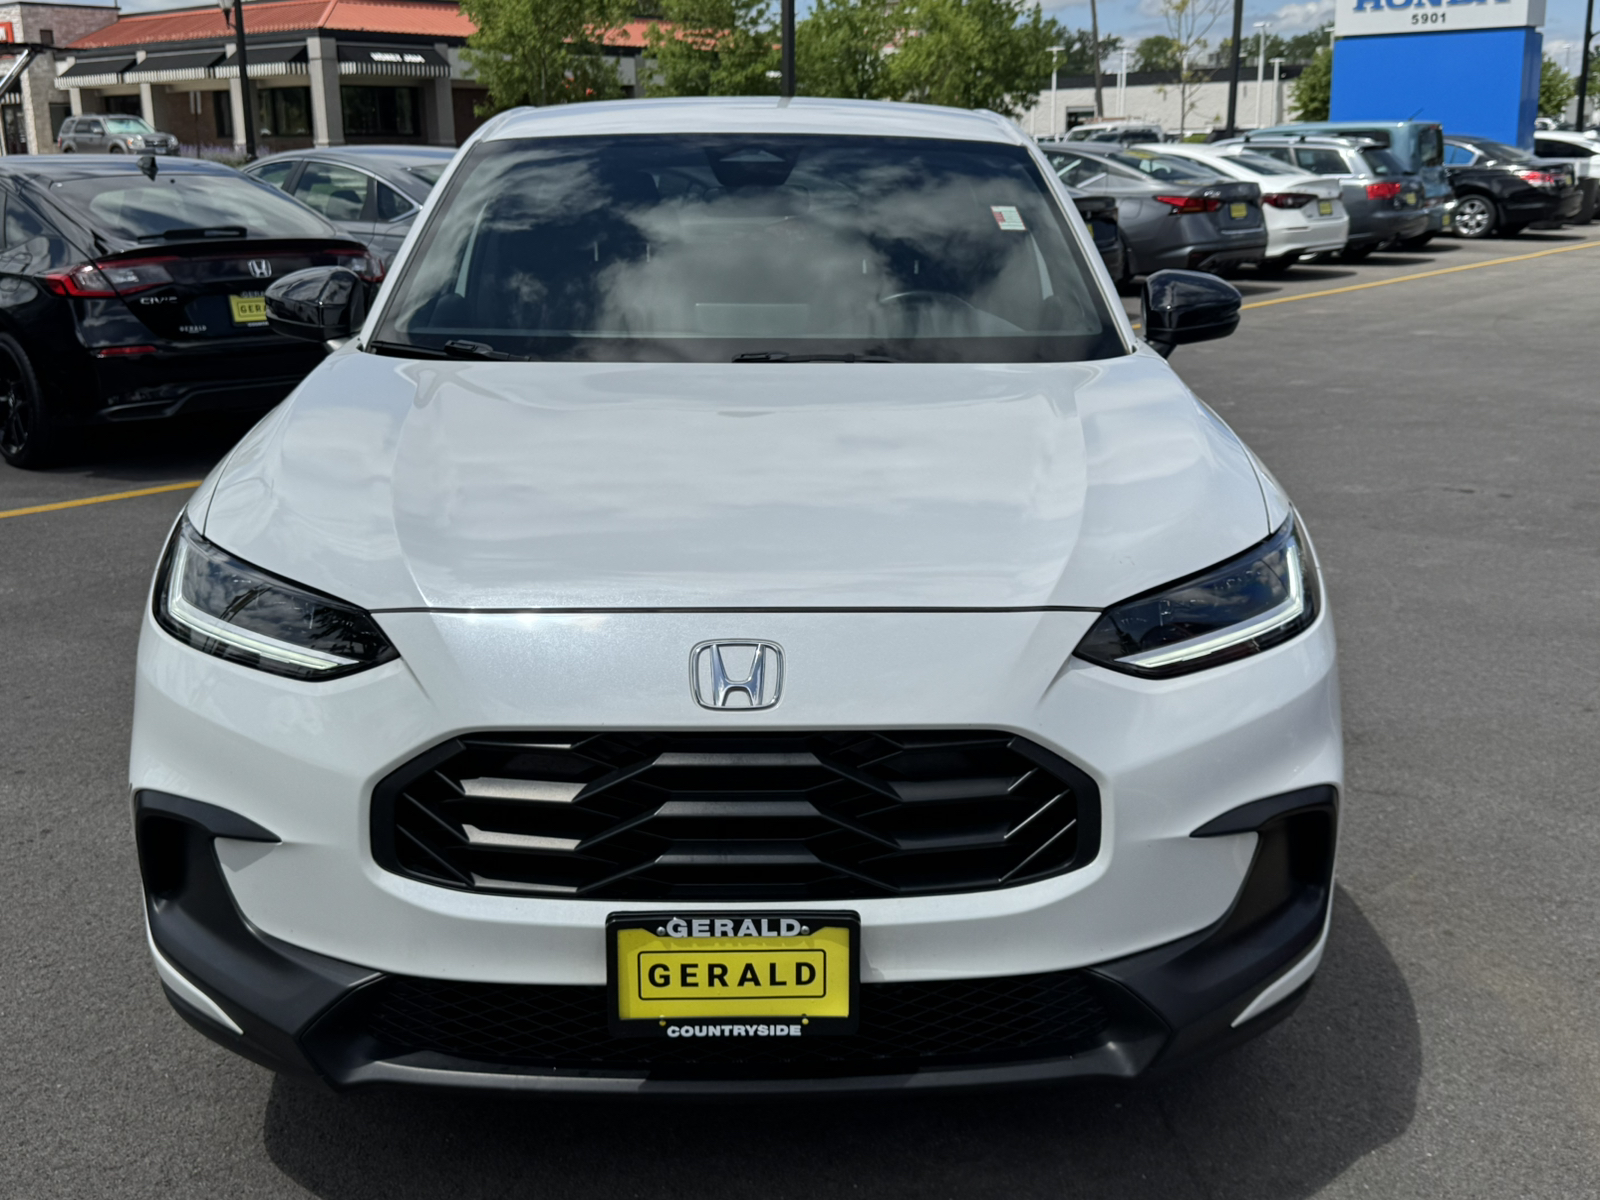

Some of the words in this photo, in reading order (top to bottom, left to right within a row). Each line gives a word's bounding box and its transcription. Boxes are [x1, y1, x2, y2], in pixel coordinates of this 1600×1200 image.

[1411, 12, 1447, 25] 5901
[666, 918, 801, 938] GERALD
[648, 962, 817, 988] GERALD
[666, 1024, 802, 1038] COUNTRYSIDE
